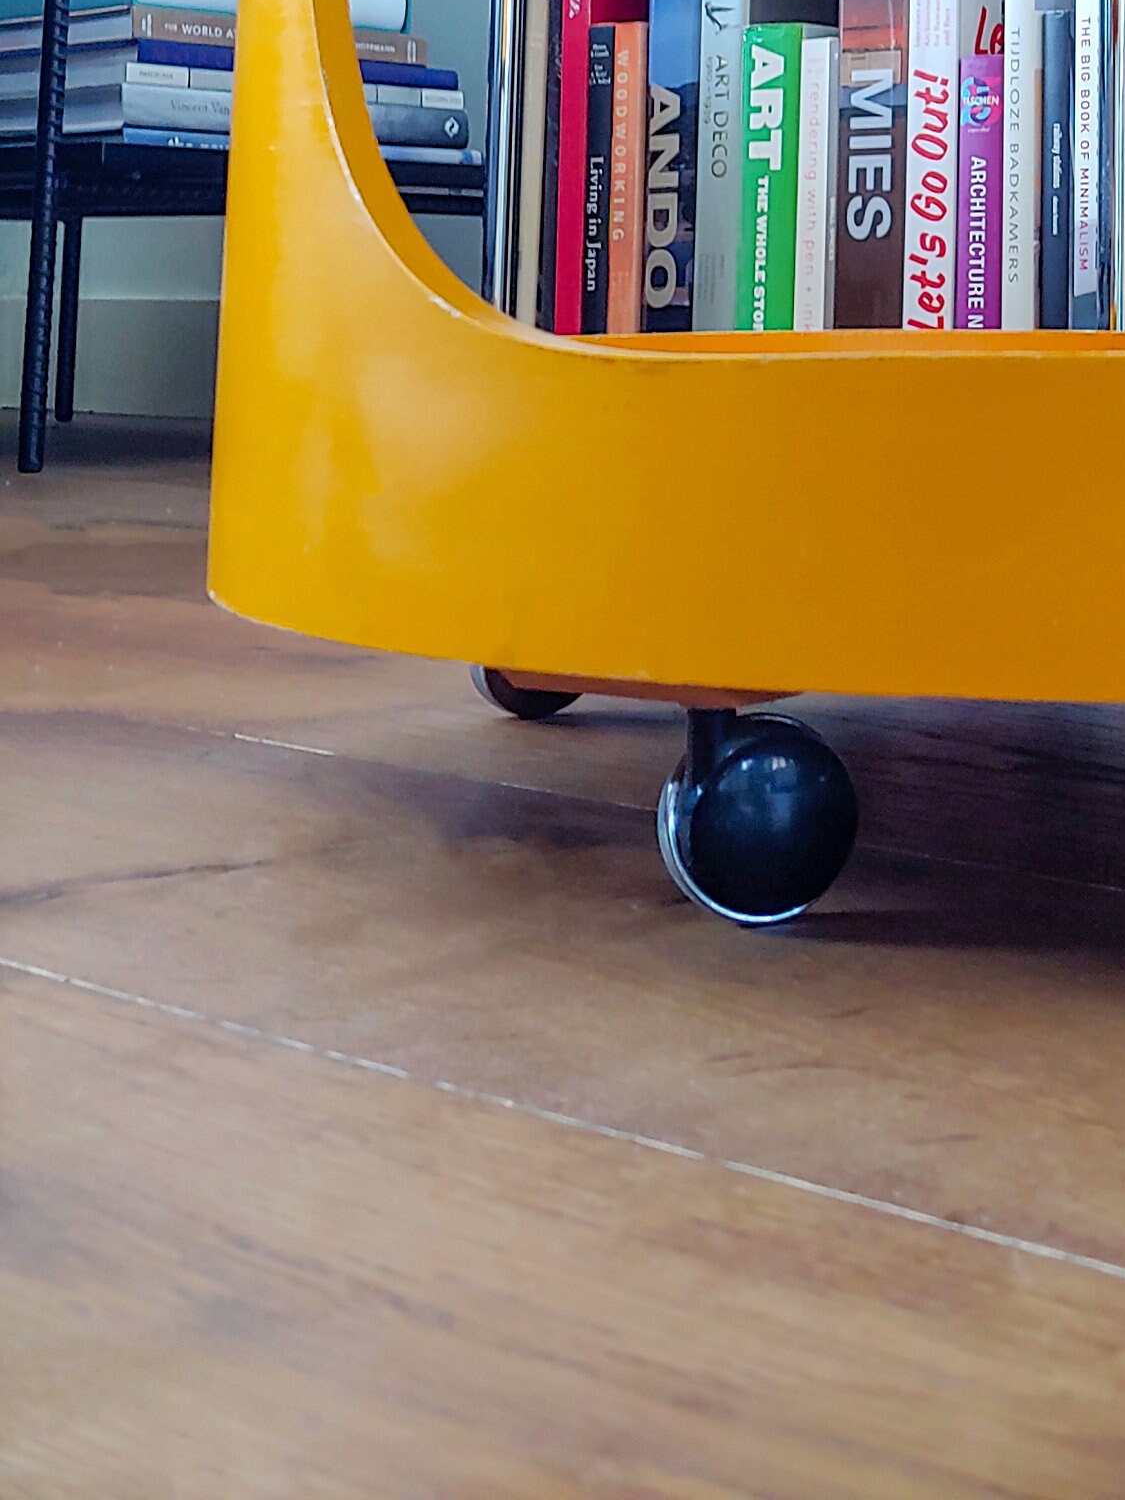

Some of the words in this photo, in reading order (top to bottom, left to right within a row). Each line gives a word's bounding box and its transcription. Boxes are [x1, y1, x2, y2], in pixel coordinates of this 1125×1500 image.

[182, 22, 222, 38] WORLD
[1081, 16, 1091, 48] THE
[714, 54, 730, 101] ART
[1009, 27, 1021, 132] TIJDLOZE
[1081, 54, 1091, 82] BIG
[171, 99, 208, 113] Vincent
[749, 44, 785, 172] ART
[804, 82, 821, 181] rendering
[911, 69, 950, 161] Out!
[1080, 89, 1090, 133] BOOK
[613, 49, 630, 241] WOODWORKING
[711, 110, 729, 179] DECO
[846, 68, 893, 242] MIES
[1080, 140, 1089, 161] OF
[586, 156, 604, 215] Living
[645, 83, 681, 309] ANDO
[756, 174, 770, 213] THE
[910, 171, 948, 222] Go
[1008, 143, 1020, 284] BADKAMERS
[588, 218, 602, 236] in
[754, 214, 769, 284] WHOLE
[967, 155, 987, 309] ARCHITECTURE
[1078, 168, 1089, 271] MINIMALISM
[584, 238, 602, 292] Japan
[802, 239, 815, 276] pen
[908, 232, 947, 330] Let's
